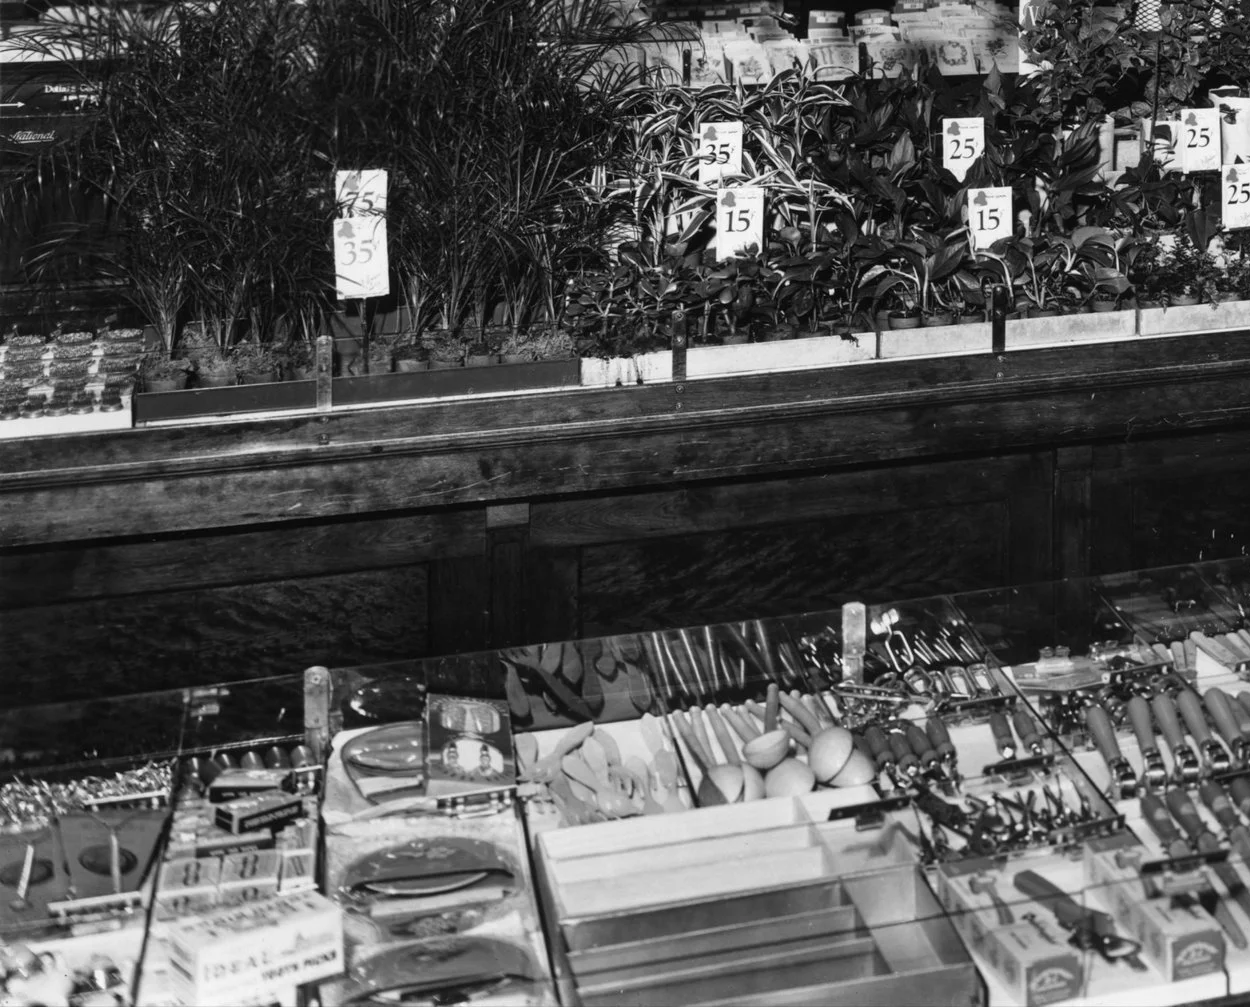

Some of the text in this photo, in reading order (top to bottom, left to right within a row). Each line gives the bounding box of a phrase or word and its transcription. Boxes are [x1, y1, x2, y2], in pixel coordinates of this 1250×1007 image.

[10, 130, 56, 144] National
[1186, 127, 1211, 148] 25
[704, 143, 731, 165] 35
[949, 138, 976, 160] 25
[725, 209, 751, 232] 15
[976, 208, 1001, 231] 15
[340, 239, 373, 266] 35
